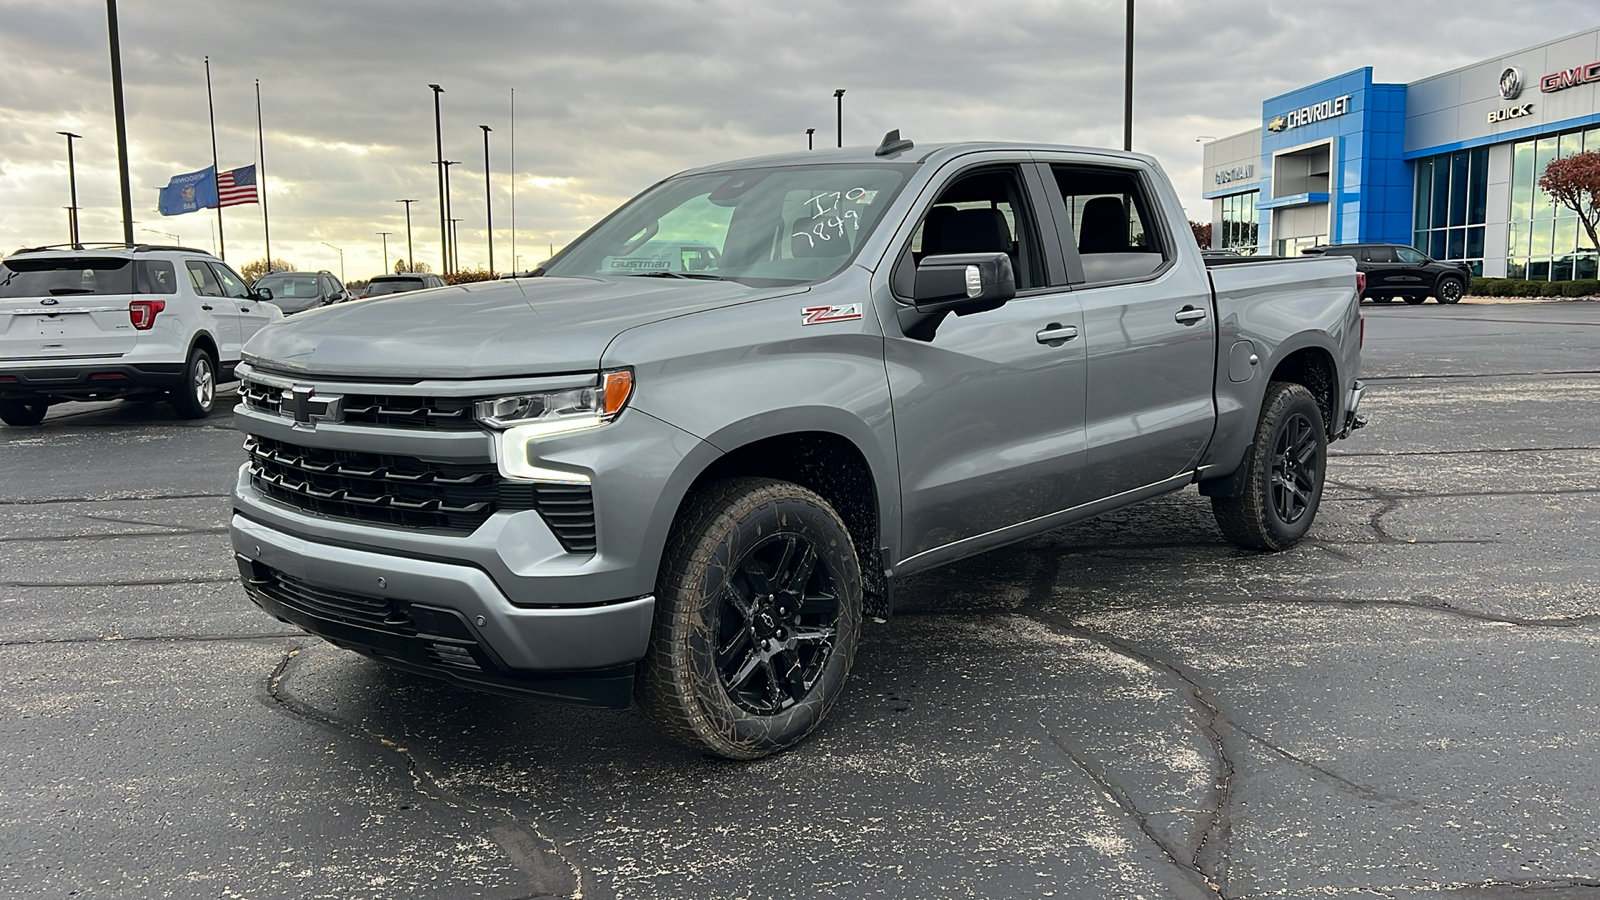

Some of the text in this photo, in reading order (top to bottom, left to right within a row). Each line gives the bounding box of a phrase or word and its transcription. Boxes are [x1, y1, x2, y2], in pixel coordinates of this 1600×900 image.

[1540, 61, 1600, 93] GMC
[1287, 95, 1350, 129] CHEVROLET
[1487, 103, 1533, 123] BUICK
[792, 210, 860, 248] 7849
[801, 302, 863, 326] Z71
